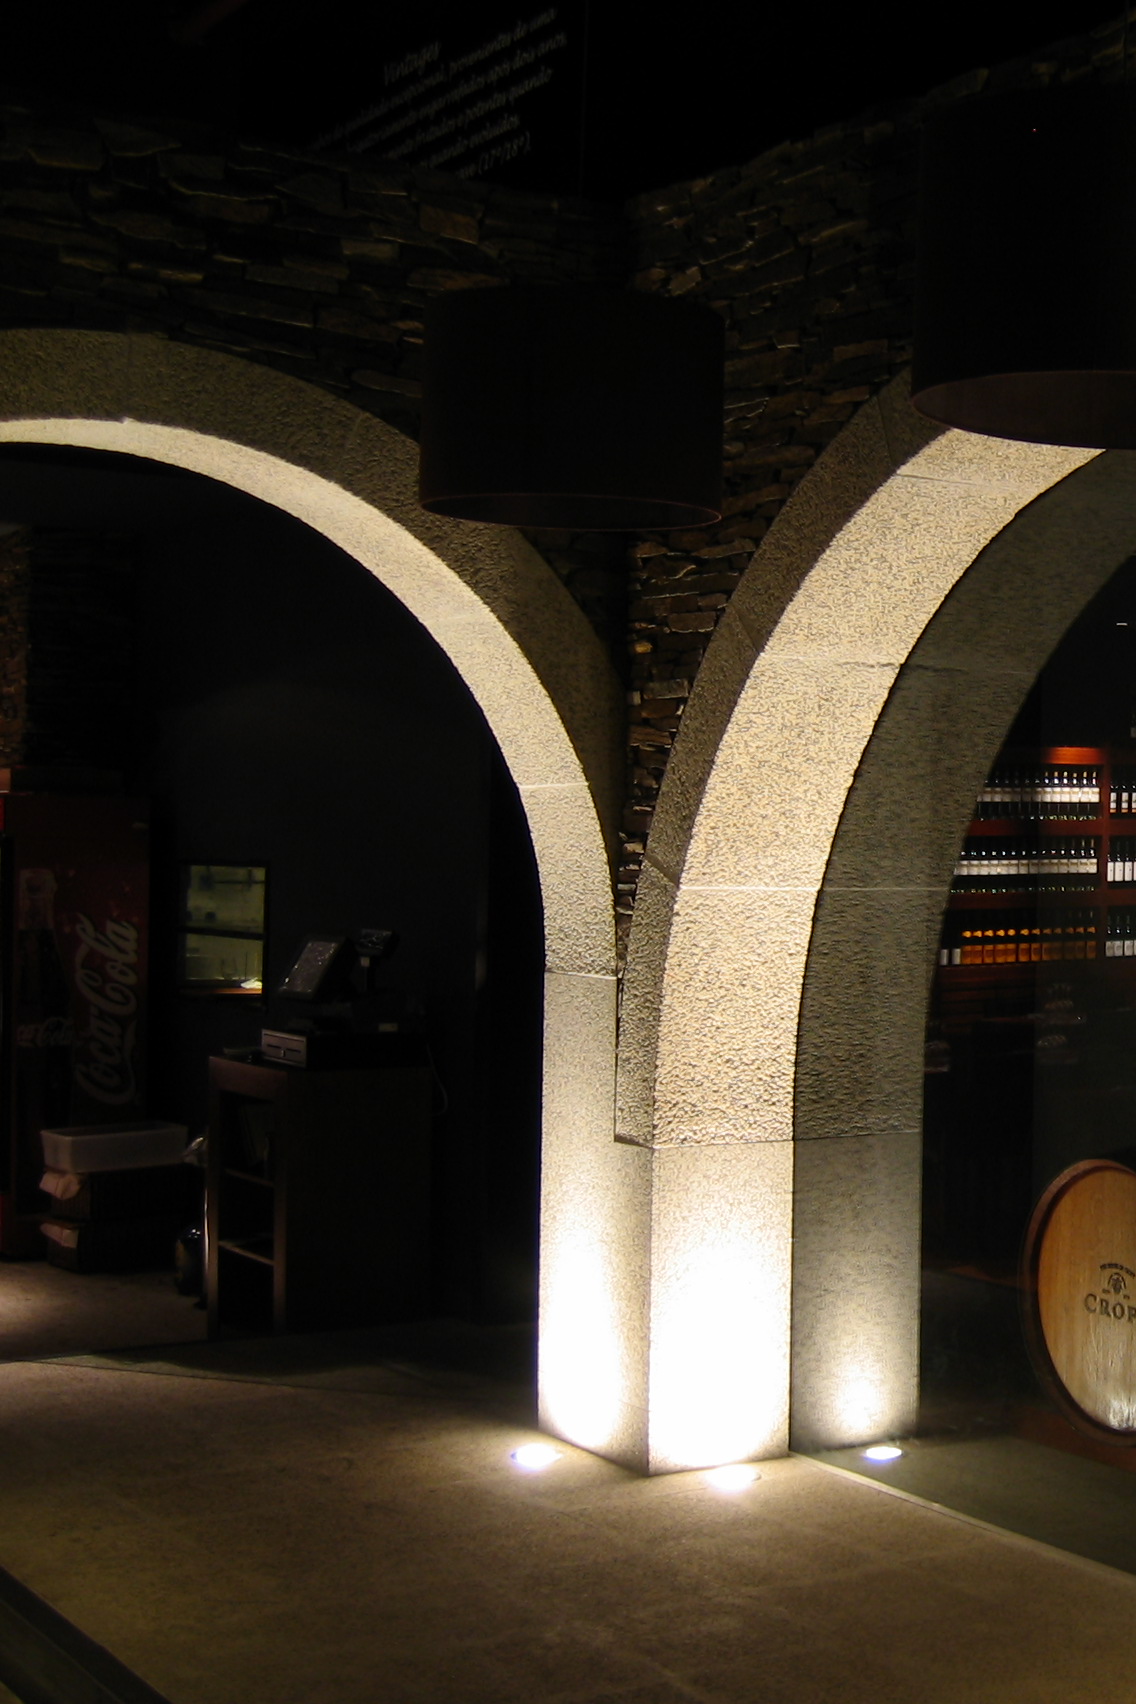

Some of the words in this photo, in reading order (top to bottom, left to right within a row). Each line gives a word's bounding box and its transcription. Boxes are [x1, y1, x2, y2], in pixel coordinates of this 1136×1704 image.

[383, 41, 441, 85] Vintages
[448, 31, 511, 79] provenientes
[512, 20, 528, 41] de
[528, 7, 557, 32] uma
[511, 47, 536, 70] dois
[463, 91, 506, 128] potentes
[507, 65, 553, 105] quando
[73, 911, 140, 1106] Coca-Cola
